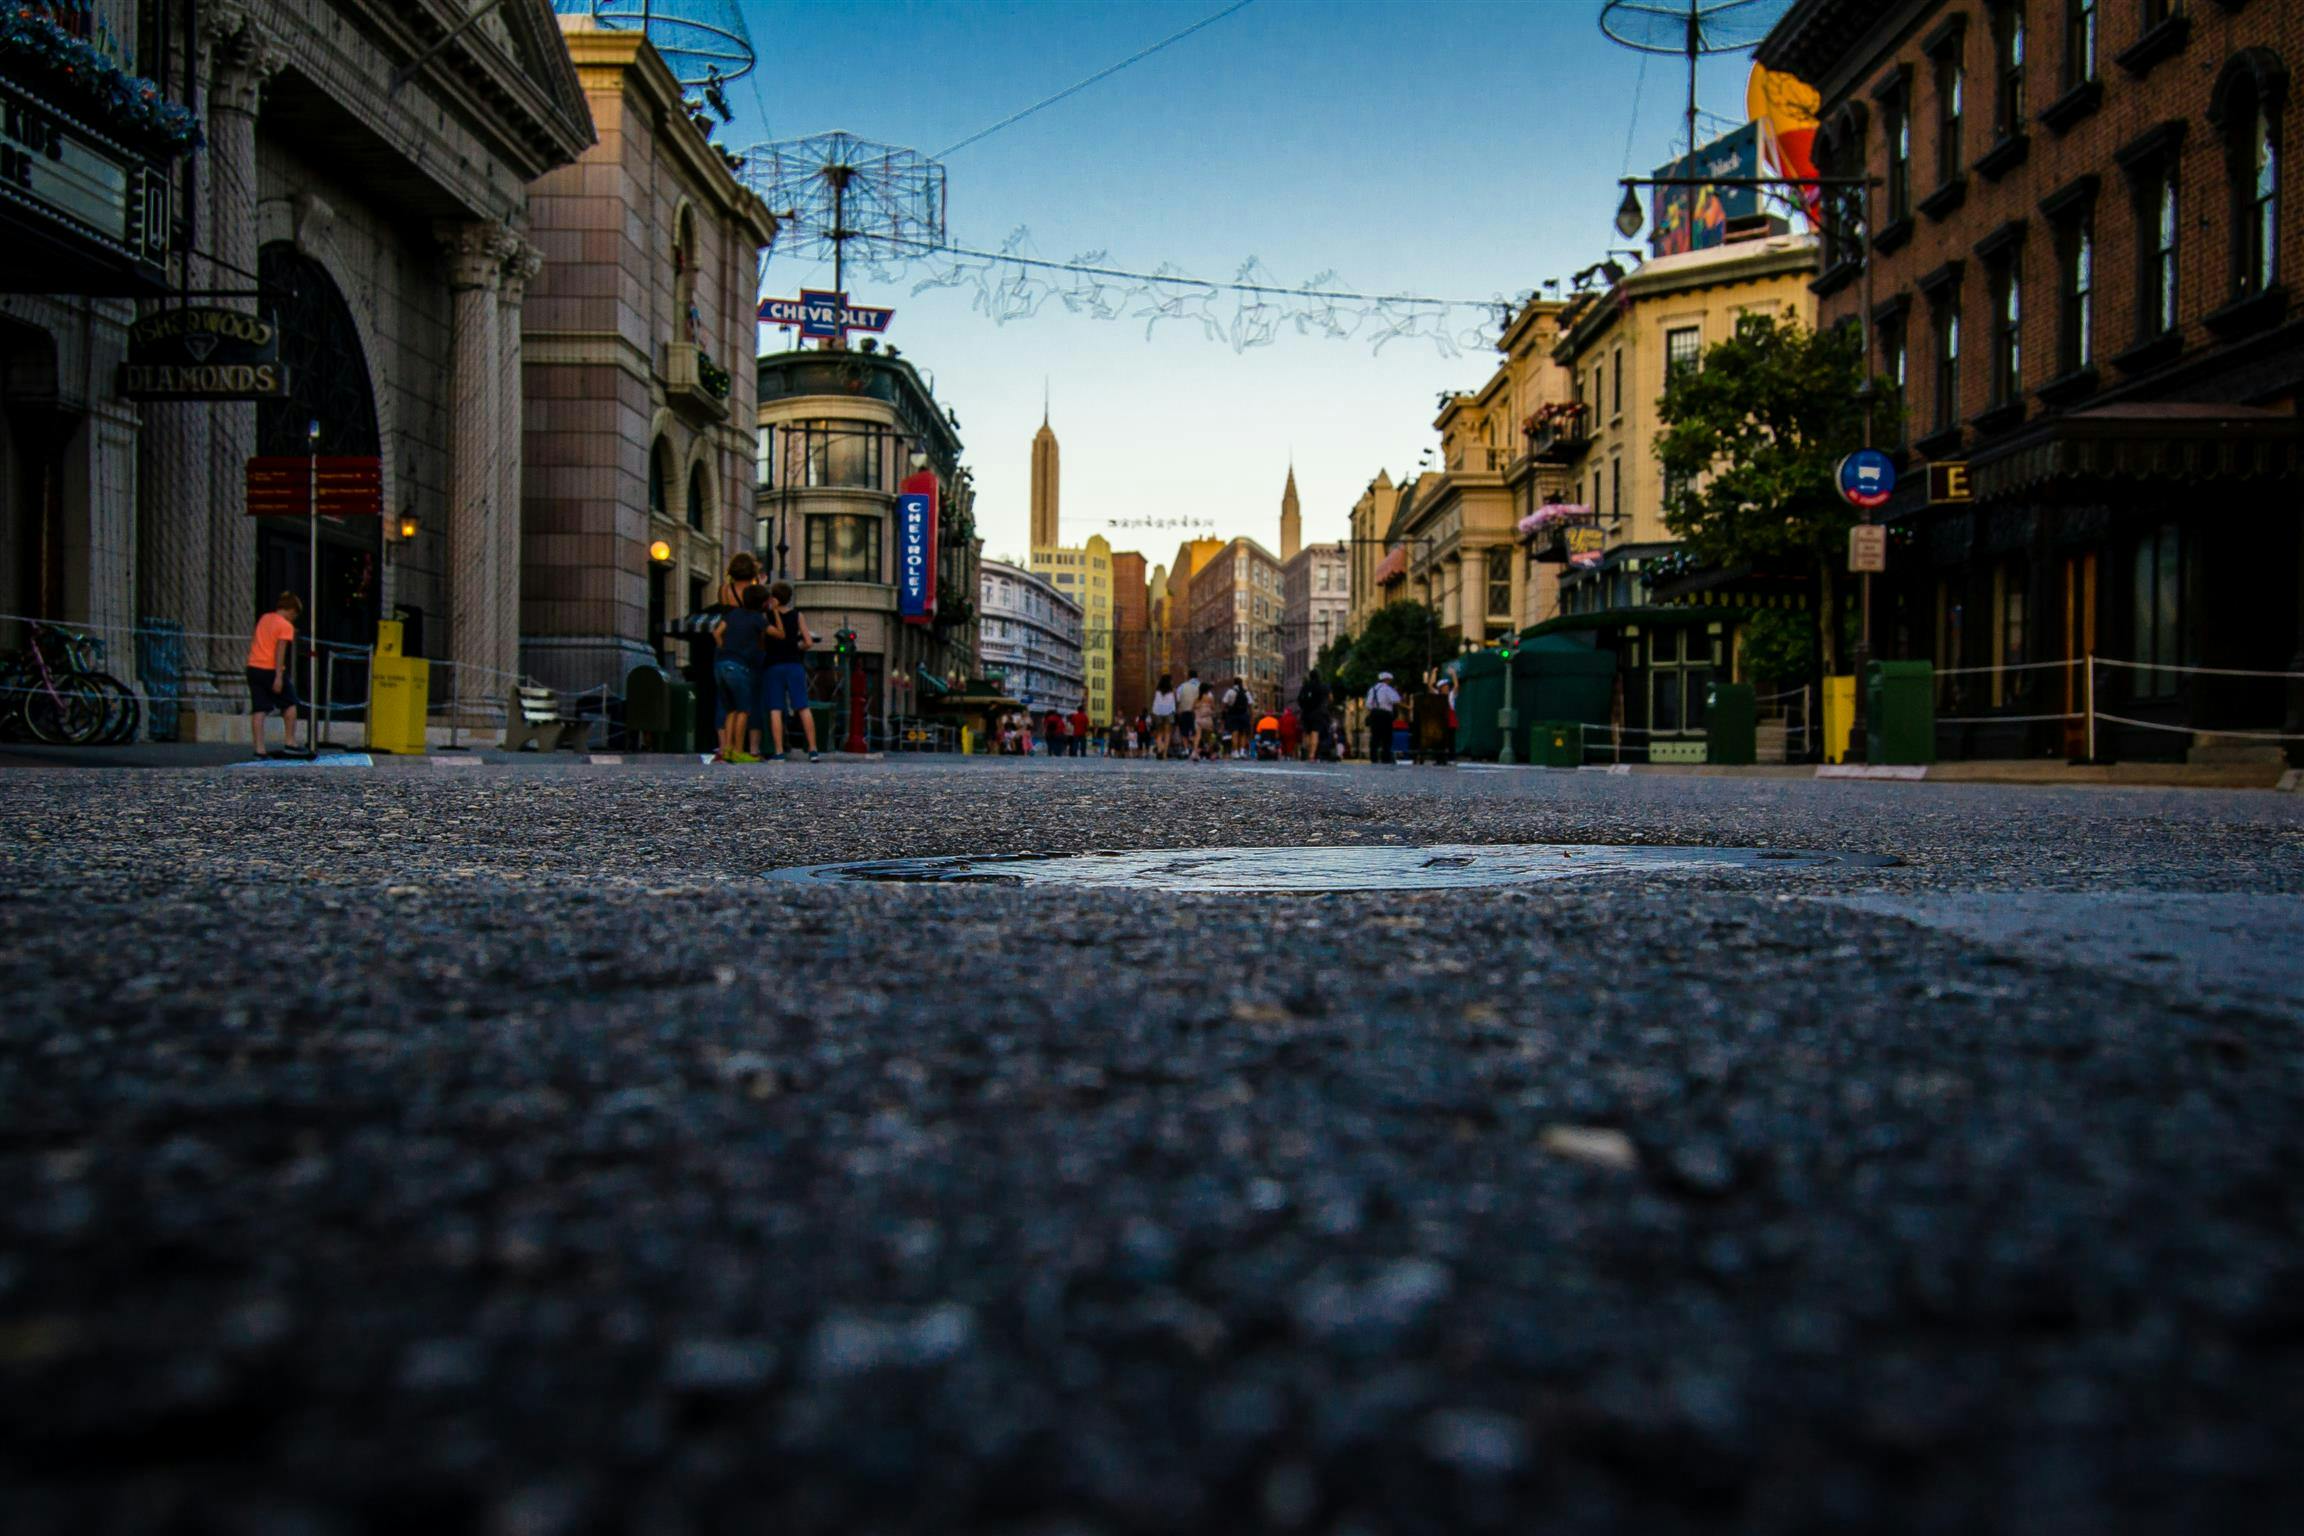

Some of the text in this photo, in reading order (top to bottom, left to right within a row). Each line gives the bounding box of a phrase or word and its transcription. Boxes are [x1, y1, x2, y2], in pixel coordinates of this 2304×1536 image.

[770, 303, 878, 327] CHEVROLET
[126, 364, 276, 392] DIAMONDS
[1946, 466, 1971, 498] E
[907, 502, 922, 597] CHEVROLET
